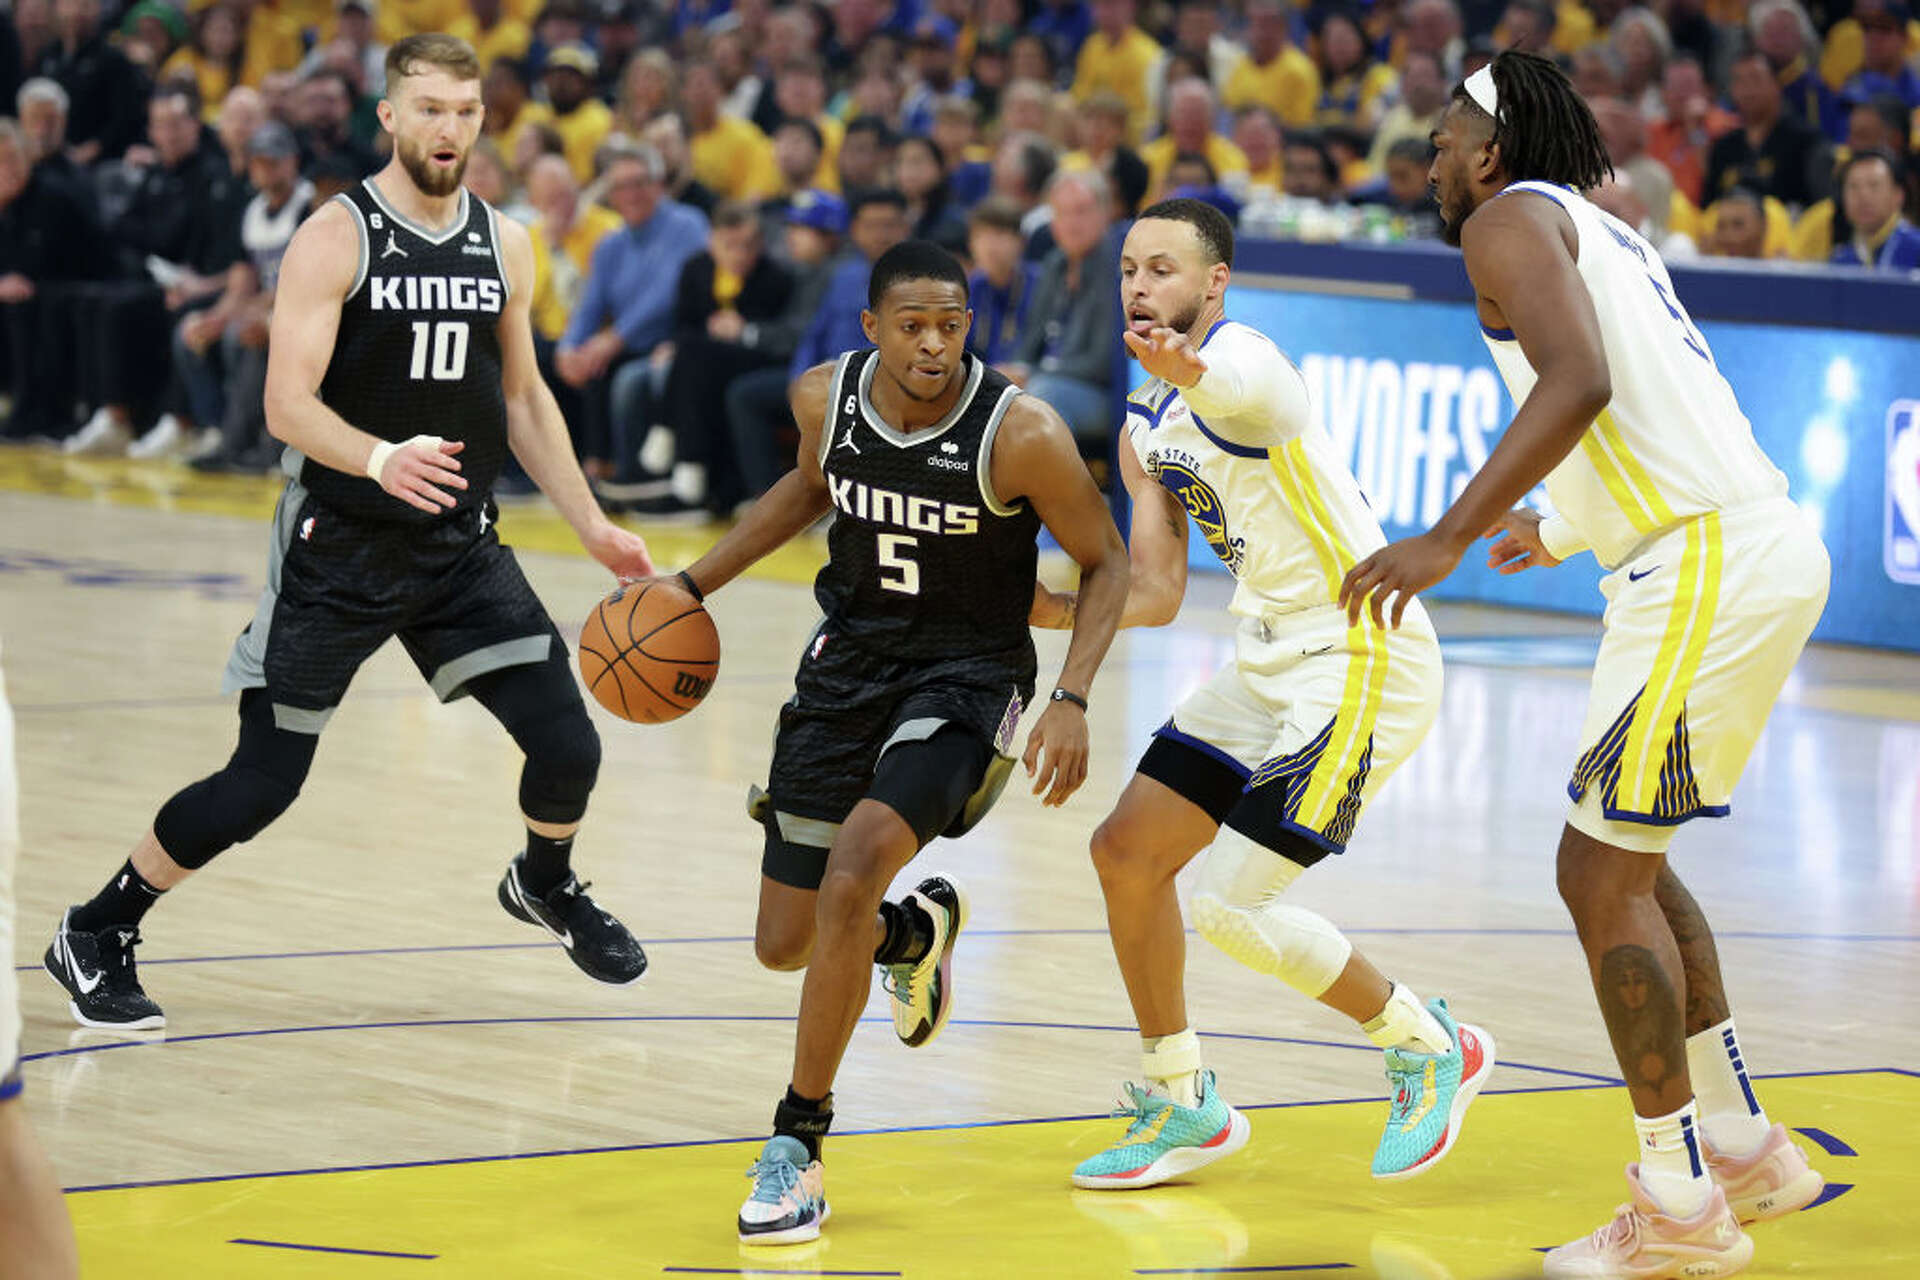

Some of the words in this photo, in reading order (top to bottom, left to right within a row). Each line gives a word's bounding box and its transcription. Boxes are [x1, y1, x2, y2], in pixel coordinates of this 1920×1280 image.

[370, 276, 501, 313] KINGS
[410, 321, 469, 380] 10
[844, 394, 857, 415] 6
[927, 455, 968, 472] dialpad
[828, 473, 979, 535] KINGS
[1178, 484, 1213, 516] 30
[877, 533, 920, 595] 5
